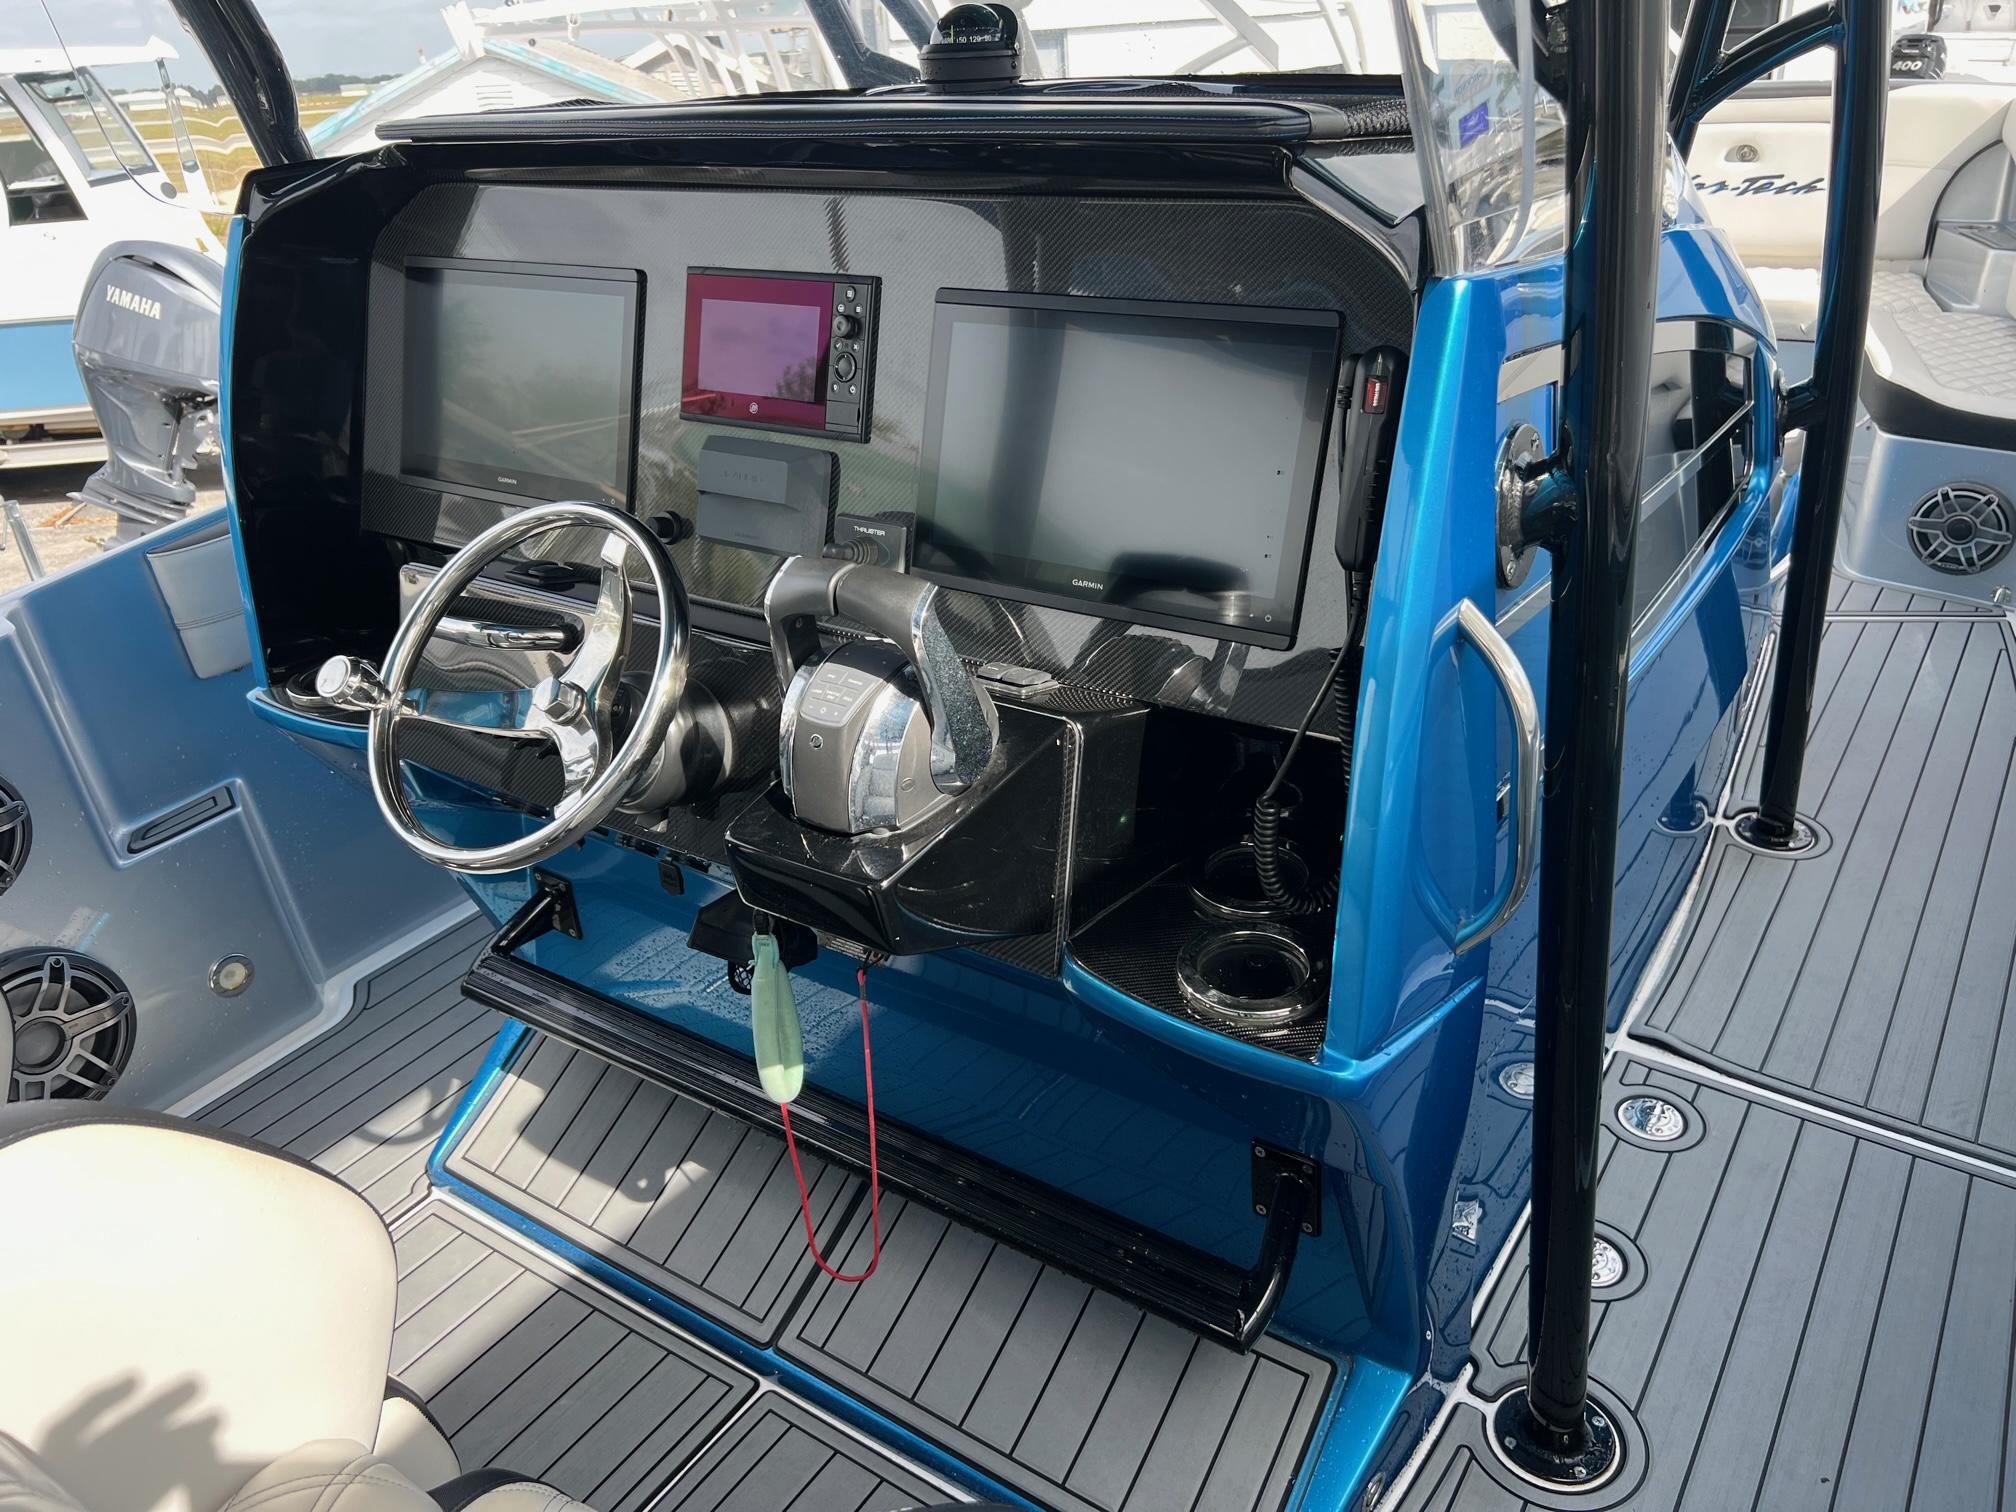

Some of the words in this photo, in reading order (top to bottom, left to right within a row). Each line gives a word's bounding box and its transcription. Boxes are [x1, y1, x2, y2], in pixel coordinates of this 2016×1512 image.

[1892, 60, 1922, 71] 400
[1691, 174, 1826, 197] or-Tech
[106, 284, 161, 320] YAMAHA
[853, 525, 886, 537] THRUSTER
[1072, 578, 1104, 590] GARMIN
